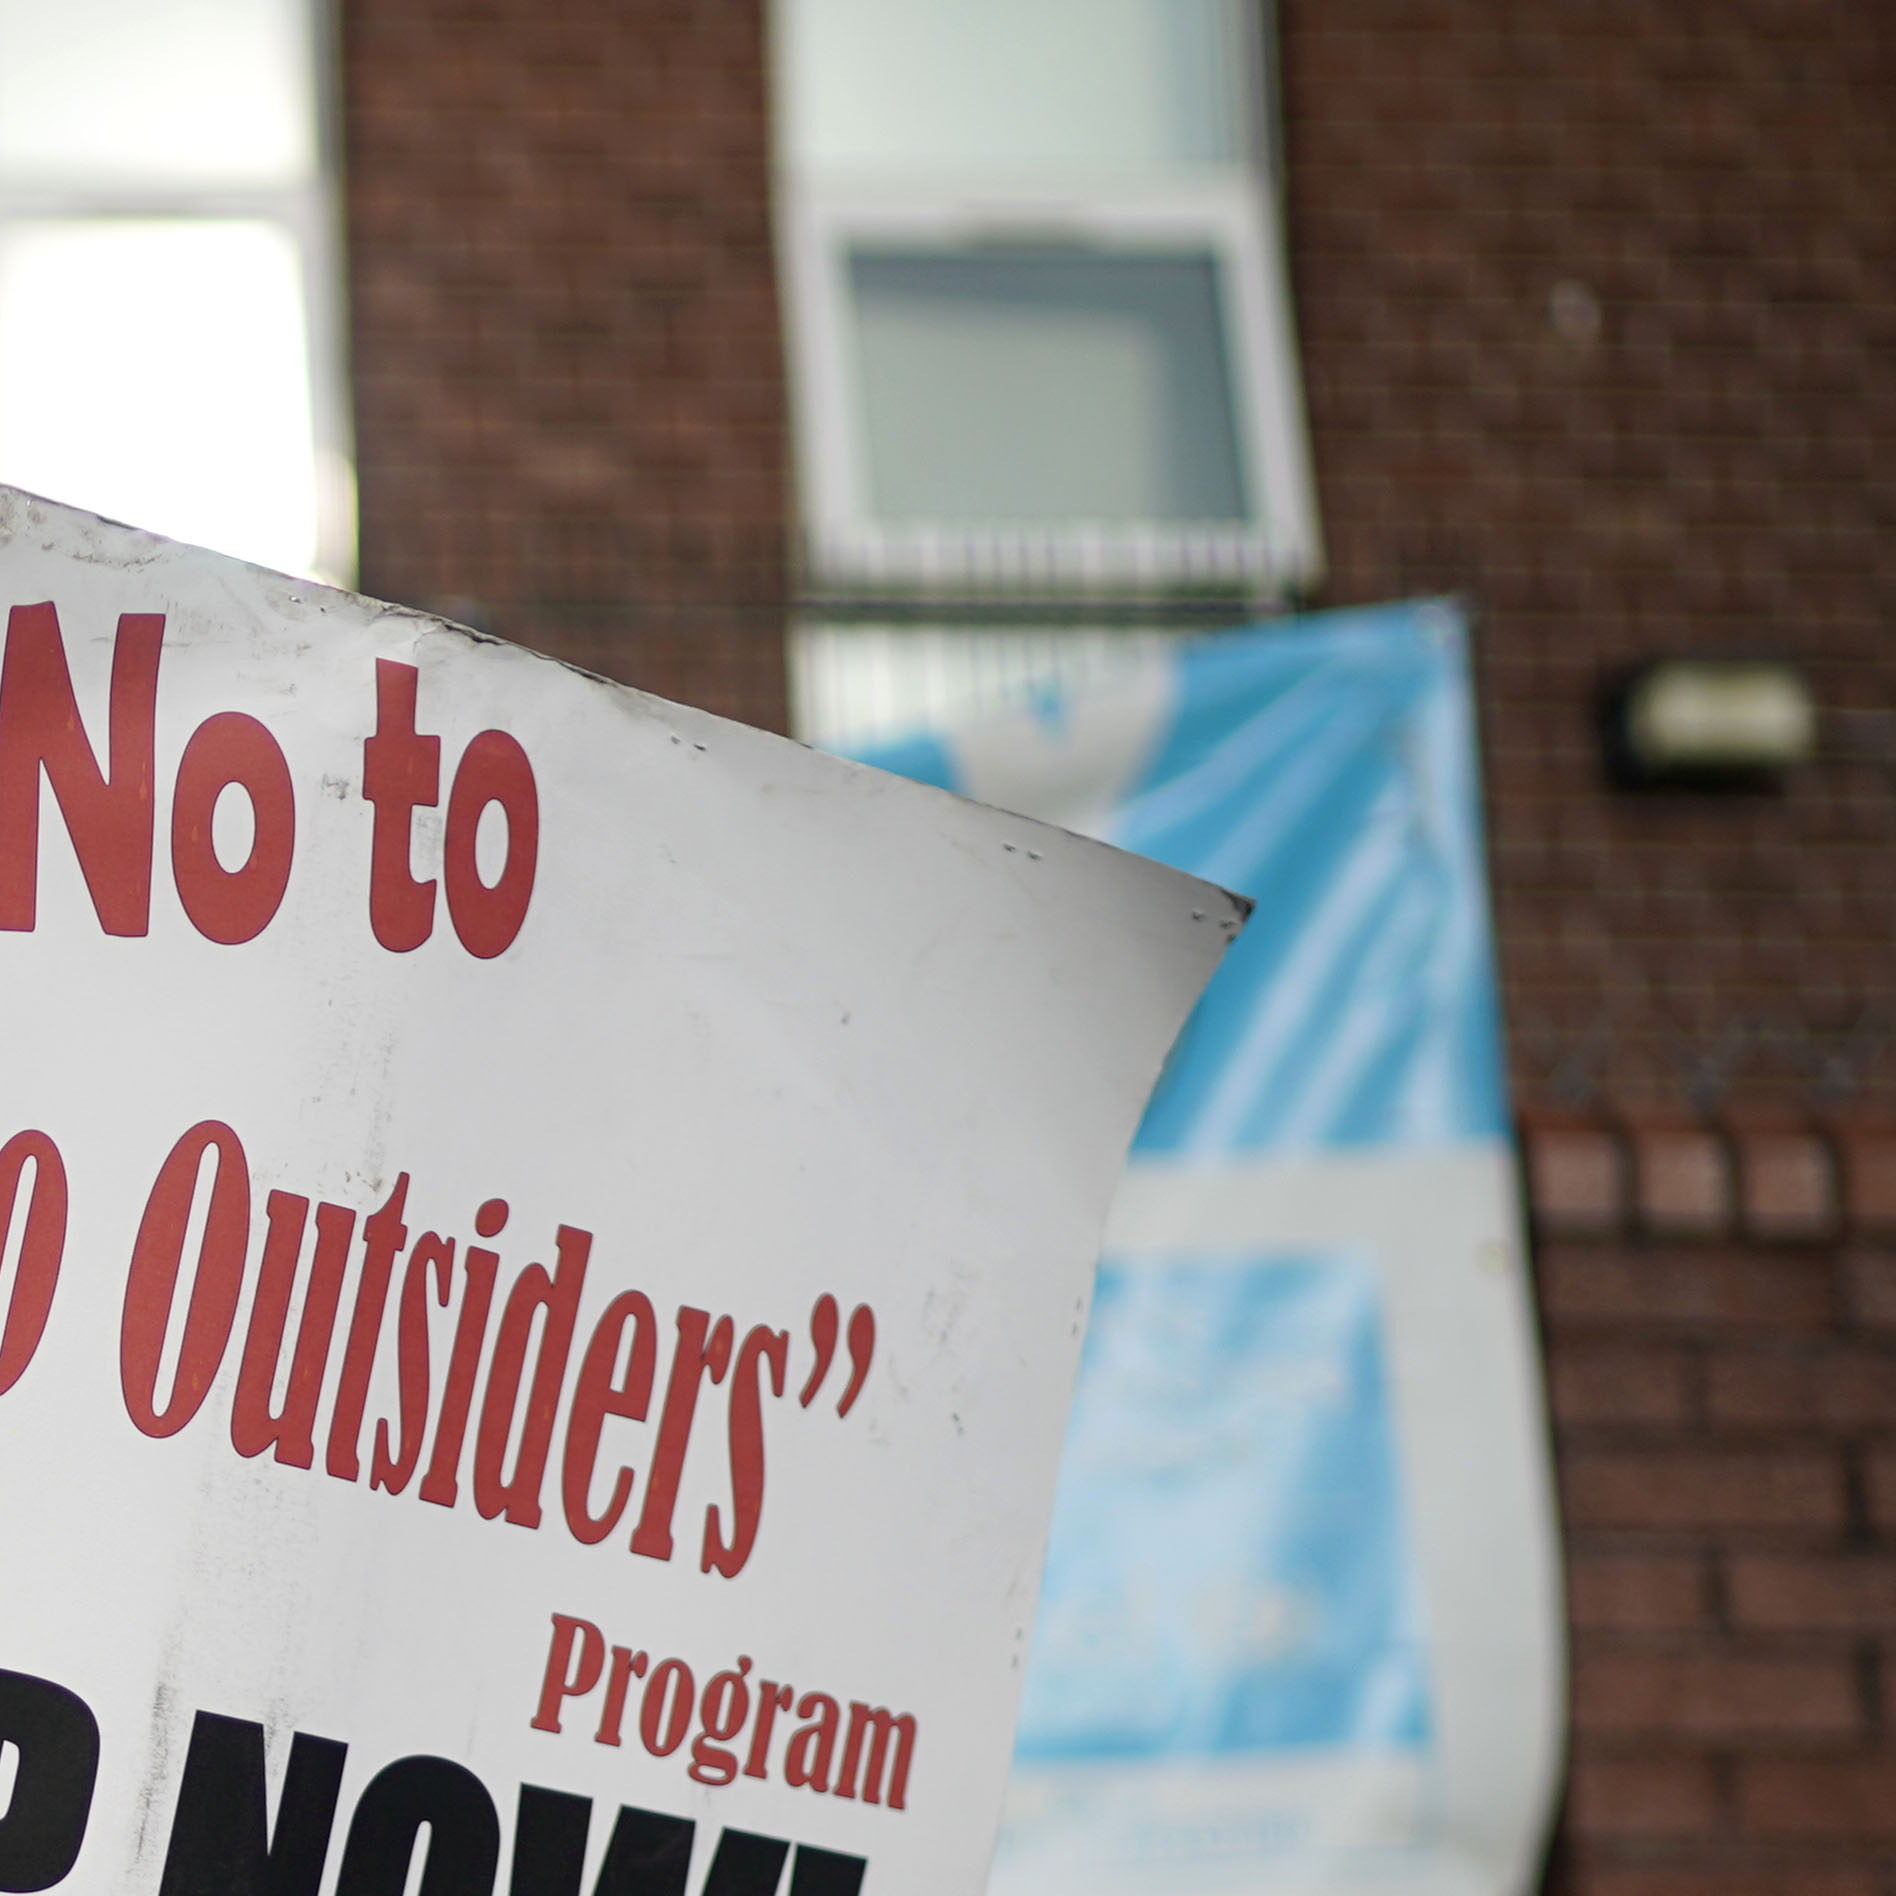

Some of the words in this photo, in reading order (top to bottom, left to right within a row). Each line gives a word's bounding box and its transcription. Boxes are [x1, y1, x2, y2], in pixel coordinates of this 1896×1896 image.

[362, 657, 539, 959] to
[118, 1119, 876, 1580] Outsiders”
[530, 1613, 919, 1811] Program
